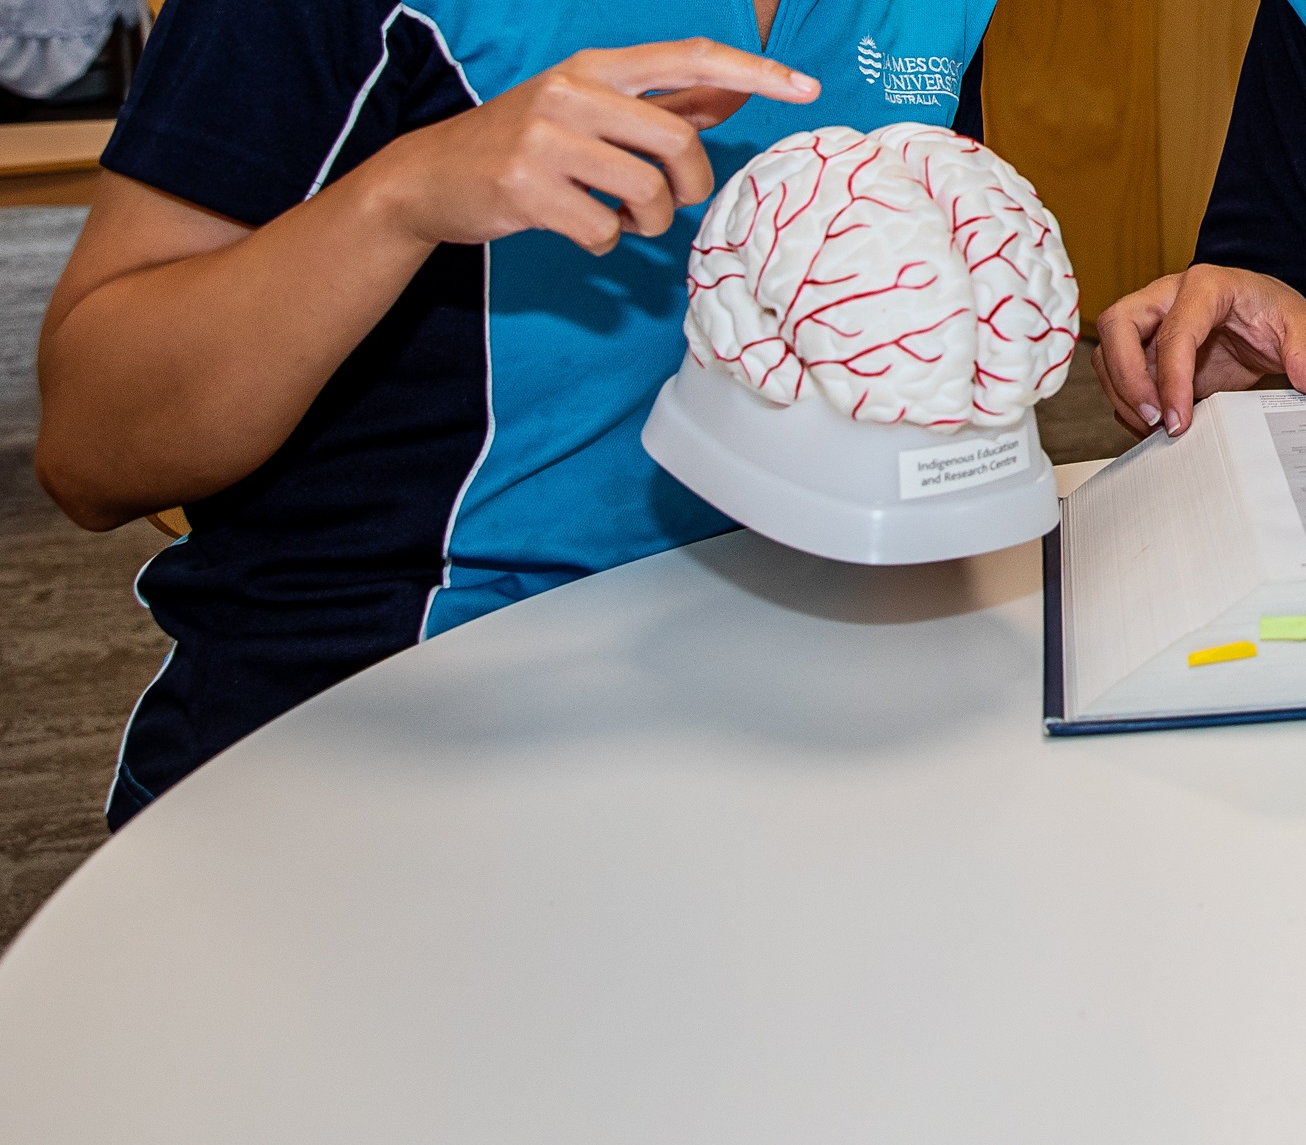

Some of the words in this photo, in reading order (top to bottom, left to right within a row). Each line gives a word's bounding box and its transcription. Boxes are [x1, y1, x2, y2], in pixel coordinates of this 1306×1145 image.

[883, 52, 927, 73] JAMES
[885, 92, 941, 106] AUSTRALIA
[917, 452, 975, 472] Indigenous
[977, 440, 1019, 459] Education
[921, 472, 942, 486] and
[944, 464, 988, 482] Research
[989, 455, 1017, 471] Centre
